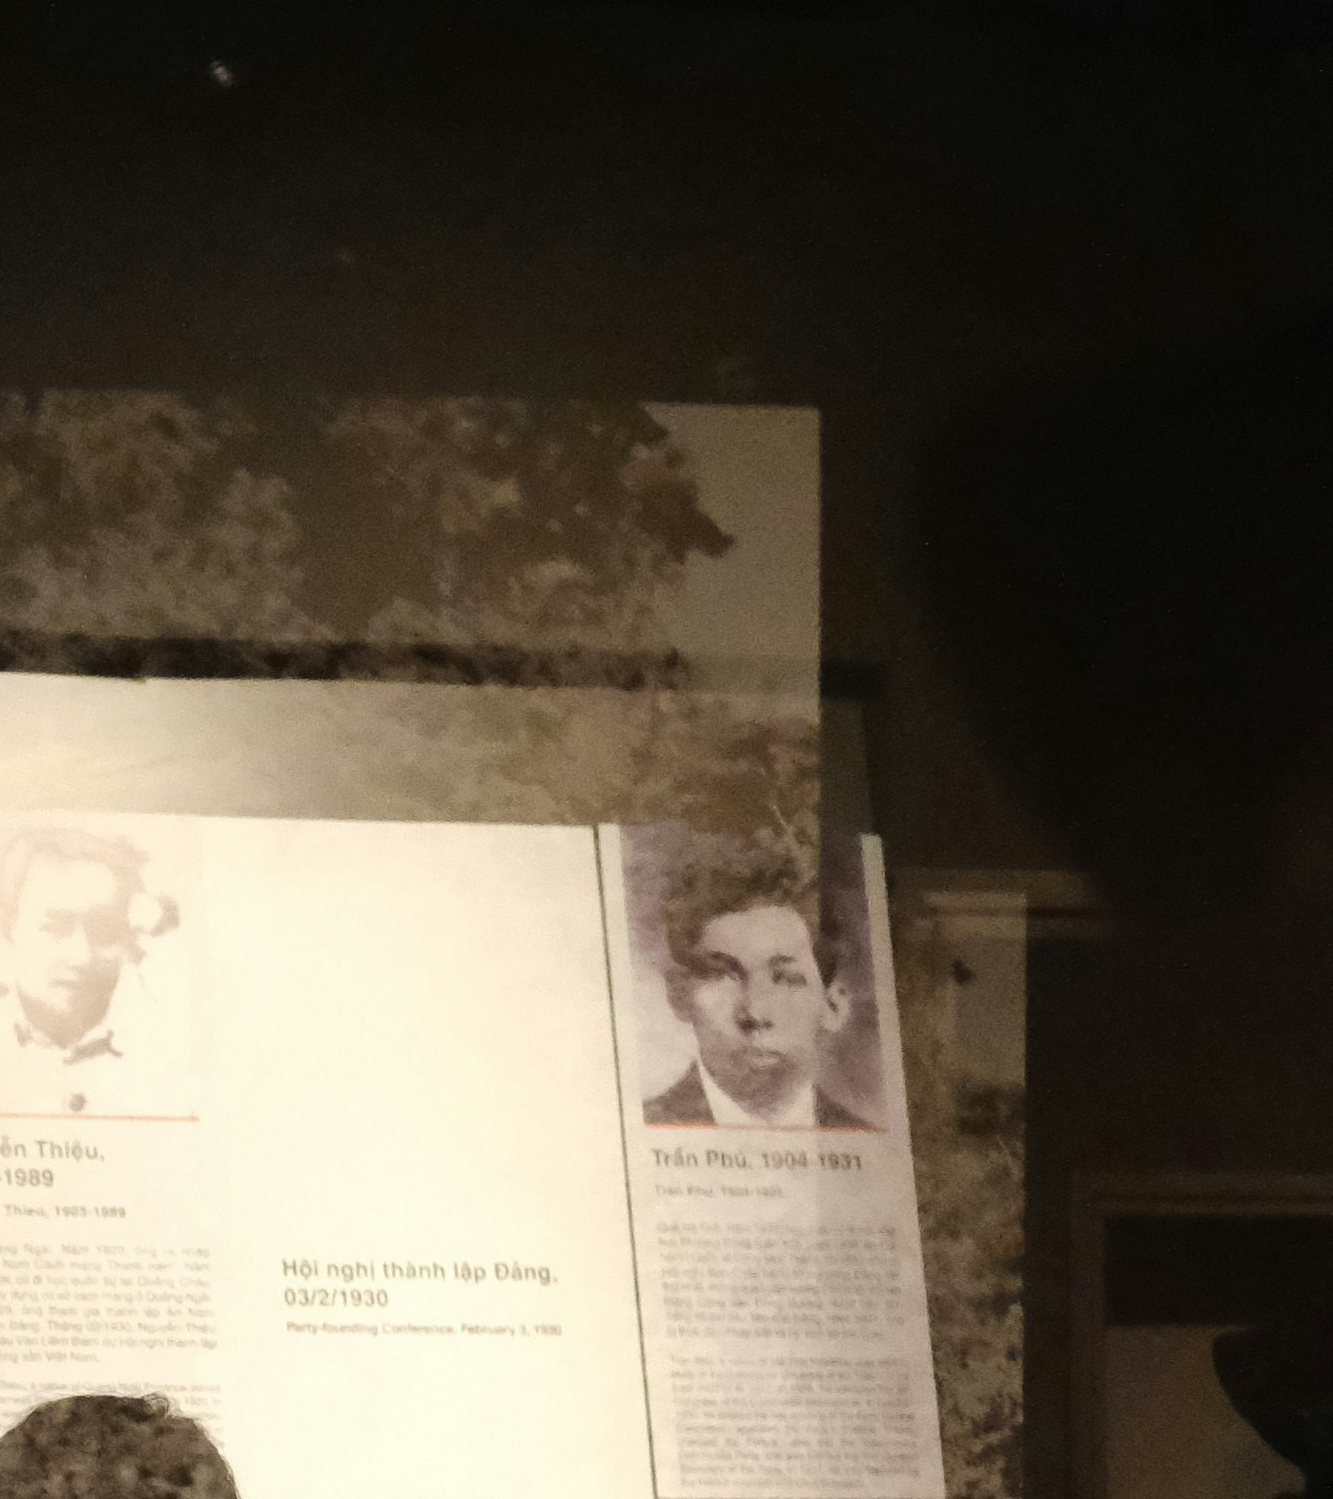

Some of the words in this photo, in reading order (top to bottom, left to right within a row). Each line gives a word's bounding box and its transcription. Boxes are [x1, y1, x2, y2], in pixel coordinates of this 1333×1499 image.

[282, 1259, 319, 1281] Hội
[326, 1261, 376, 1283] nghị
[383, 1261, 446, 1279] thành
[453, 1261, 487, 1284] lập
[283, 1288, 389, 1308] 03/2/1930
